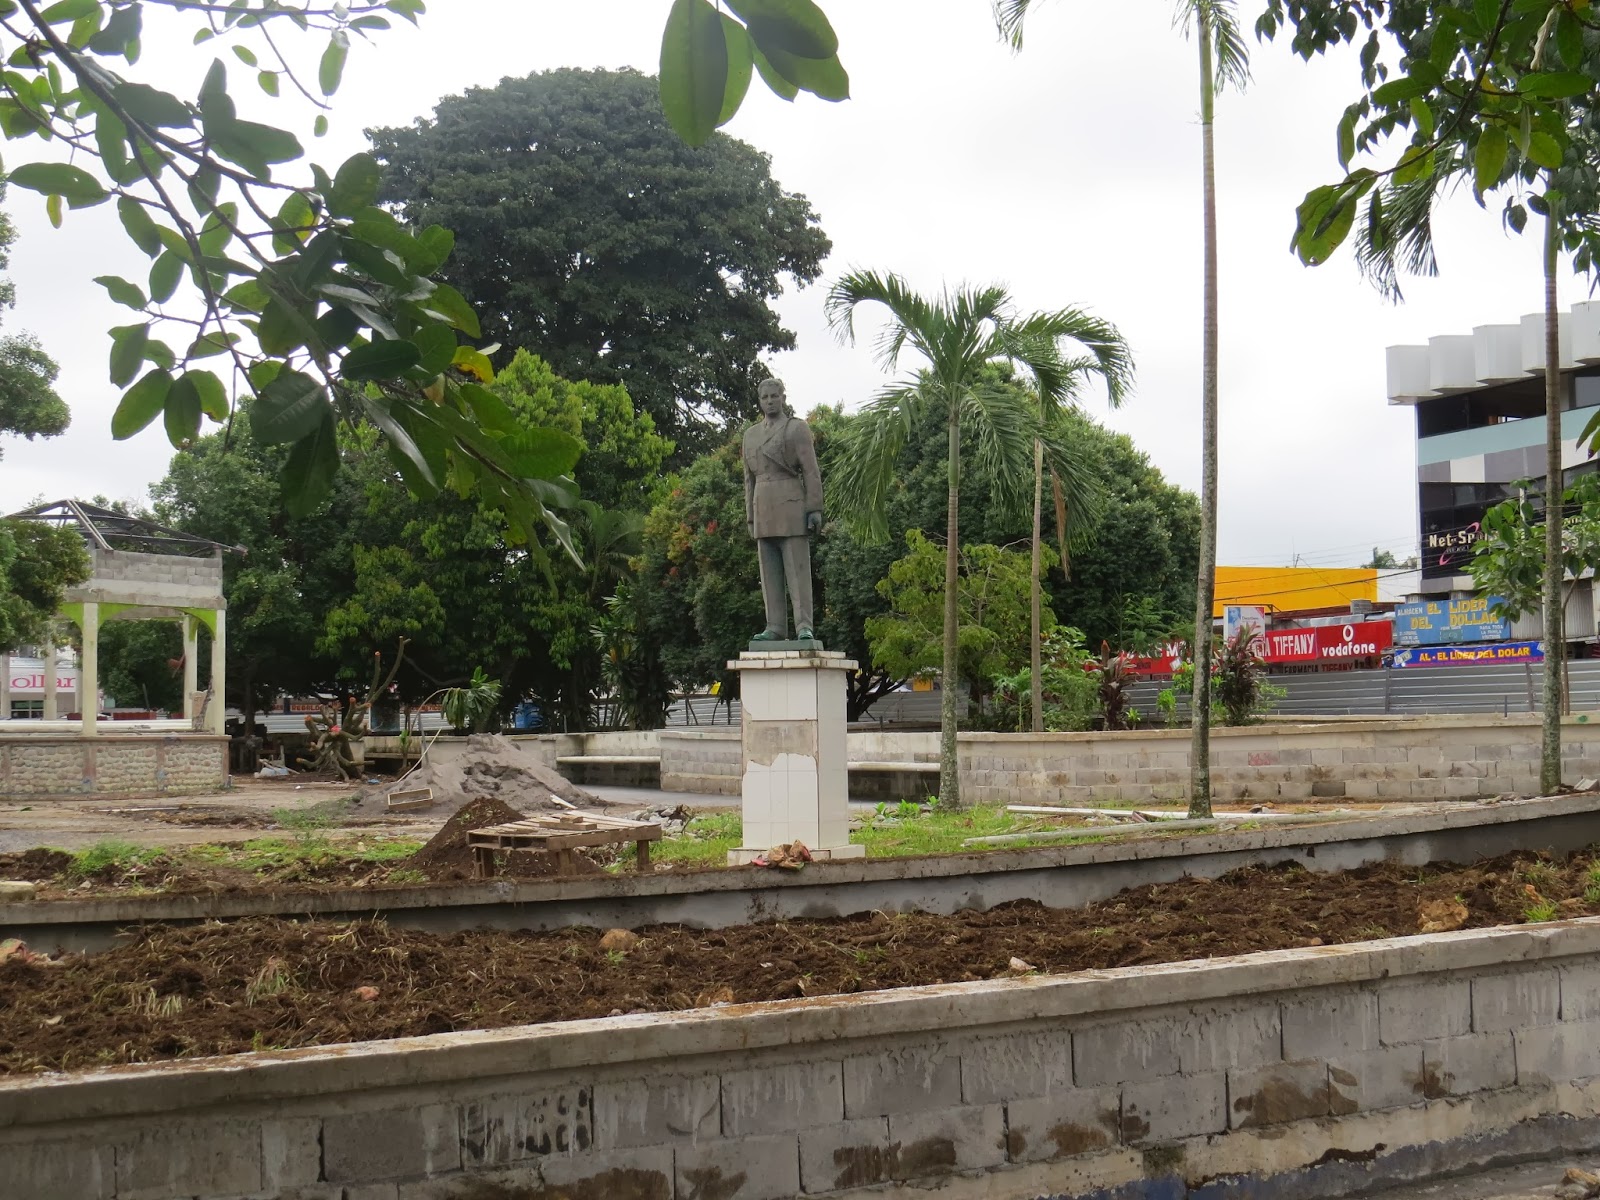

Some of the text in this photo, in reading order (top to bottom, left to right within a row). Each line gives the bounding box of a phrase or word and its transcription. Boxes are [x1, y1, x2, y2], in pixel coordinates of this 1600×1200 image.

[1397, 599, 1487, 616] ALMACEN EL LIDER
[1411, 611, 1499, 630] DEL DOLLAR
[1273, 633, 1315, 656] TIFFANY
[1322, 642, 1376, 657] vodafone
[1419, 653, 1431, 662] AL
[1437, 652, 1448, 661] EL
[1450, 650, 1475, 660] LIDER
[1477, 649, 1495, 659] DEL
[1498, 647, 1530, 658] DOLAR
[11, 674, 76, 688] ollar
